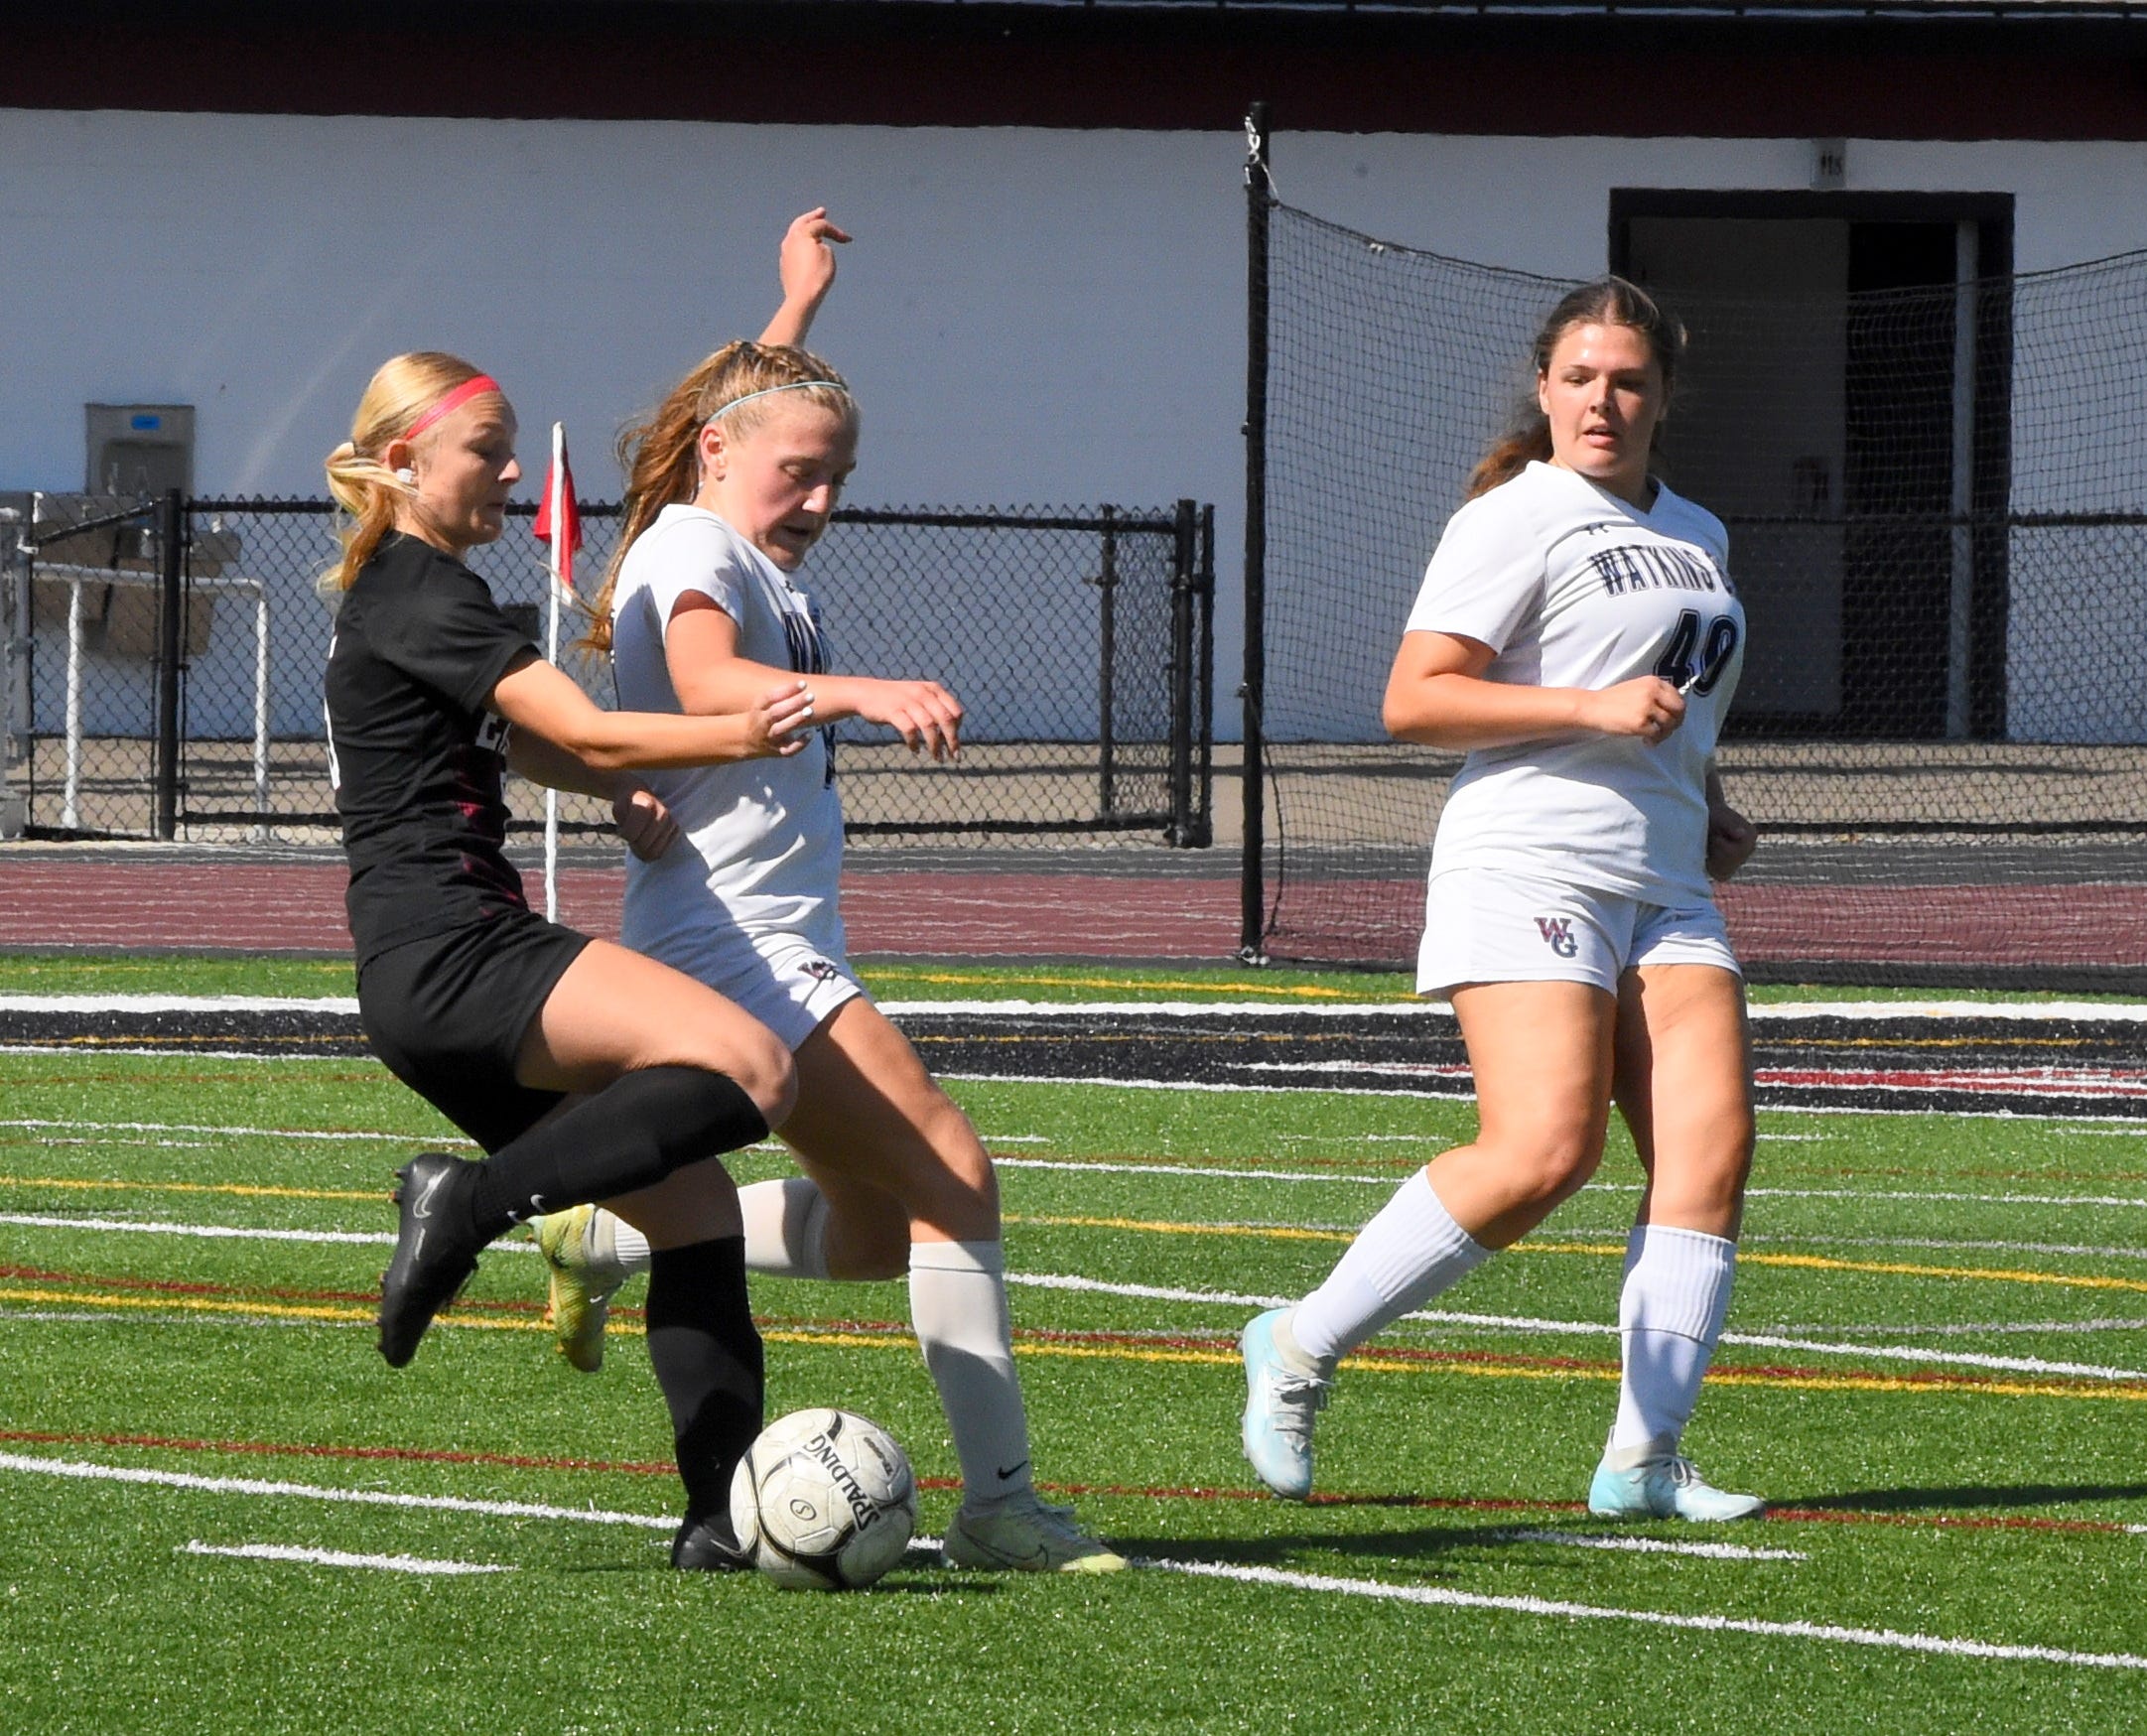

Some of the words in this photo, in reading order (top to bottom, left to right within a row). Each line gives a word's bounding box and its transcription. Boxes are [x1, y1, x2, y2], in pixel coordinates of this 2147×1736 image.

[1653, 608, 1737, 697] 40
[1534, 917, 1578, 958] WG
[803, 1432, 880, 1532] SPALDING
